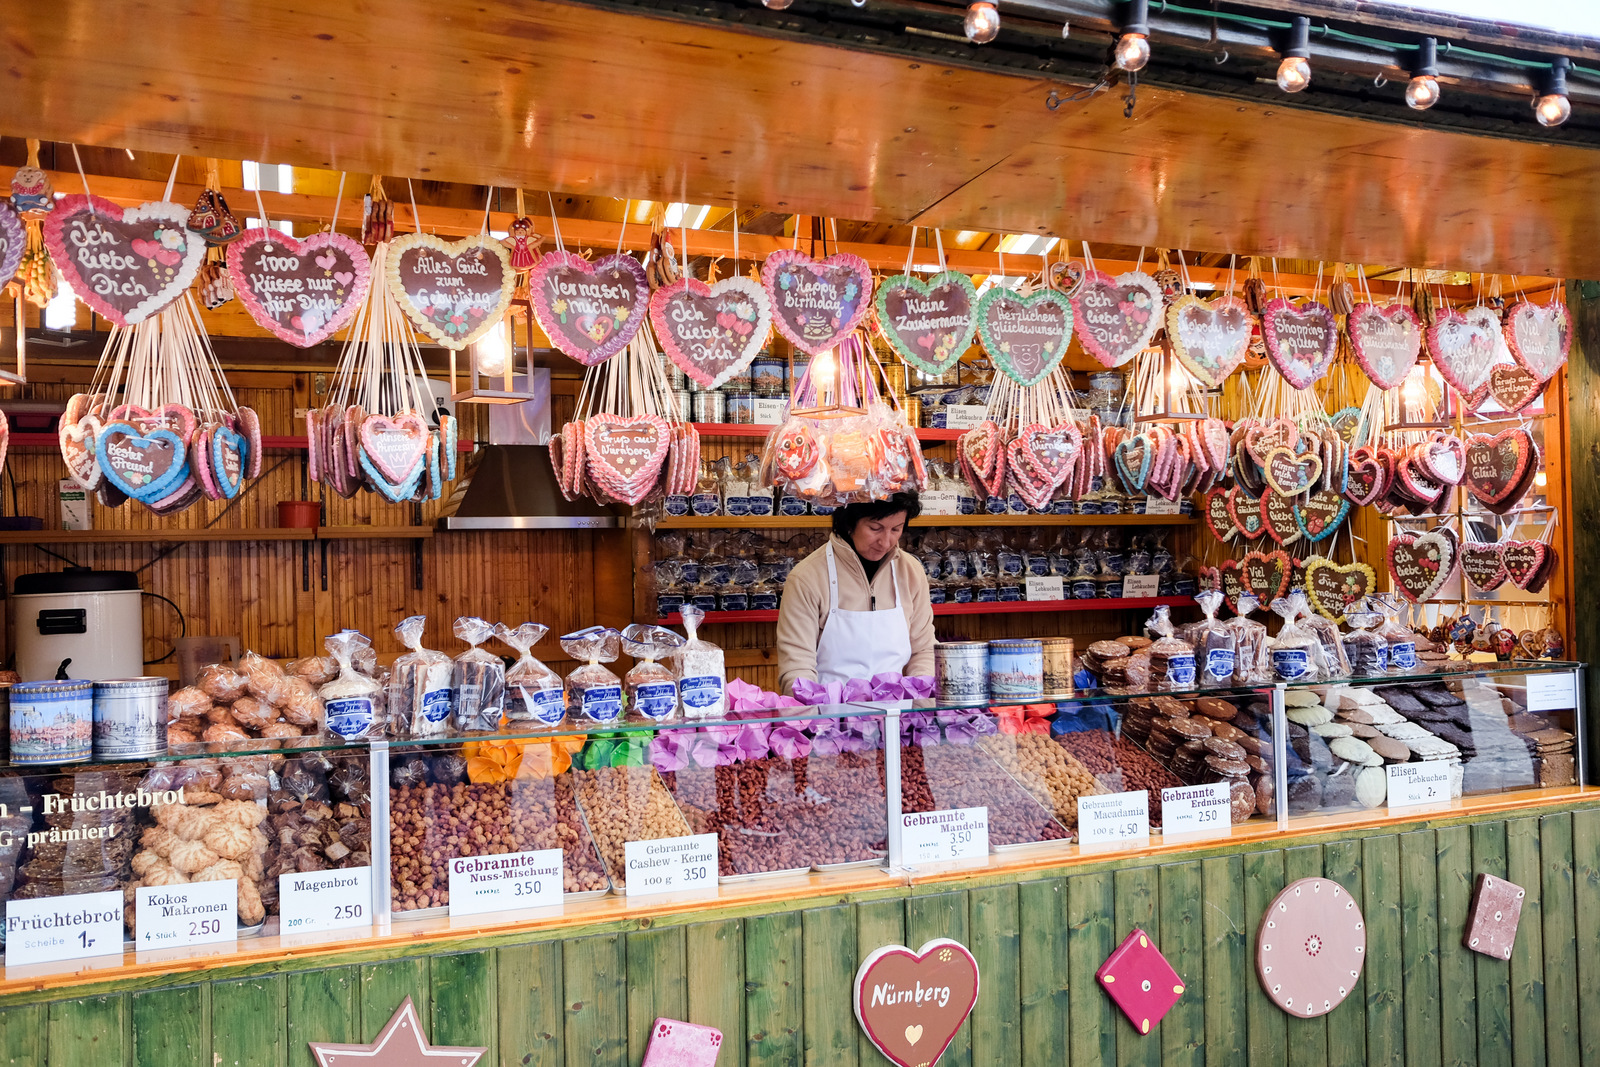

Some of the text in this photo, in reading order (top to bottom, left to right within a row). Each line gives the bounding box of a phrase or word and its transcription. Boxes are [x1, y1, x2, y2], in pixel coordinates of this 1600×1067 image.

[77, 246, 141, 274] liebe
[255, 255, 300, 272] 1000
[413, 256, 489, 277] Alles Gute
[91, 273, 151, 298] Dich
[250, 274, 338, 294] Küsse nur
[435, 276, 466, 288] zum
[547, 275, 631, 301] Vernasch
[794, 275, 838, 302] Happy
[297, 293, 341, 312] Dich
[566, 299, 612, 316] mich
[784, 293, 846, 319] Birthday
[905, 298, 949, 314] Kleine
[997, 306, 1059, 323] Herzlichen
[1086, 310, 1121, 326] liebe
[895, 314, 971, 332] Zaubermaus
[988, 321, 1065, 341] Glückwunsch
[1226, 321, 1236, 335] is
[1521, 321, 1540, 337] Viel
[677, 323, 724, 341] liebe
[1095, 327, 1131, 345] Dich
[689, 342, 736, 362] Dich
[1288, 335, 1321, 354] queen
[1522, 338, 1548, 357] Glück
[1518, 376, 1533, 384] au
[950, 407, 967, 415] Elisen
[633, 436, 657, 444] aus
[107, 442, 145, 462] Bester
[601, 444, 653, 460] Nürnberg
[1470, 451, 1491, 465] Viel
[111, 456, 154, 474] Freund
[1272, 459, 1297, 474] Nimm
[1472, 465, 1498, 480] Glück
[1273, 468, 1294, 481] mich
[1314, 493, 1328, 503] ute
[1210, 508, 1228, 518] liebe
[1269, 509, 1294, 521] liebe
[1306, 502, 1339, 518] esserung
[1214, 519, 1230, 530] Dich
[1275, 522, 1297, 534] Dich
[1504, 553, 1536, 565] Nürnberg
[1248, 566, 1266, 578] Viel
[1292, 571, 1302, 581] ch
[1396, 565, 1422, 577] liebe
[1465, 563, 1500, 578] Nürnberg
[1251, 577, 1269, 590] Glück
[1318, 573, 1339, 588] Für
[1404, 576, 1431, 590] Dich
[1225, 585, 1242, 596] liebe
[1315, 589, 1344, 600] meine
[1390, 766, 1418, 778] Elisen
[1408, 773, 1448, 784] Lebkuchen
[41, 786, 186, 815] Früchtebrot
[1162, 787, 1215, 802] Gebrannte
[1191, 796, 1231, 808] Erdnüsse
[1081, 799, 1123, 810] Gebrannte
[903, 810, 966, 828] Gebrannte
[1094, 807, 1145, 820] Macadamia
[1198, 809, 1218, 823] 2.50
[940, 820, 985, 833] Mandeln
[1092, 822, 1138, 838] 100 g 4.50
[949, 830, 972, 844] 3.50
[646, 841, 700, 855] Gebrannte
[453, 854, 535, 874] Gebrannte
[629, 857, 671, 870] Cashew
[680, 852, 713, 864] Kerne
[469, 865, 560, 884] Nuss-Mischung
[644, 866, 707, 886] 100 g 3.50
[293, 875, 360, 894] Magenbrot
[513, 880, 543, 897] 3.50
[147, 893, 188, 907] Kokos
[161, 901, 228, 917] Makronen
[287, 918, 303, 928] 200
[333, 904, 363, 921] 2.50
[7, 907, 121, 932] Früchtebrot
[144, 918, 221, 942] 4 Stück 2.50
[24, 937, 65, 950] Scheibe
[870, 980, 951, 1009] Nürnberg
